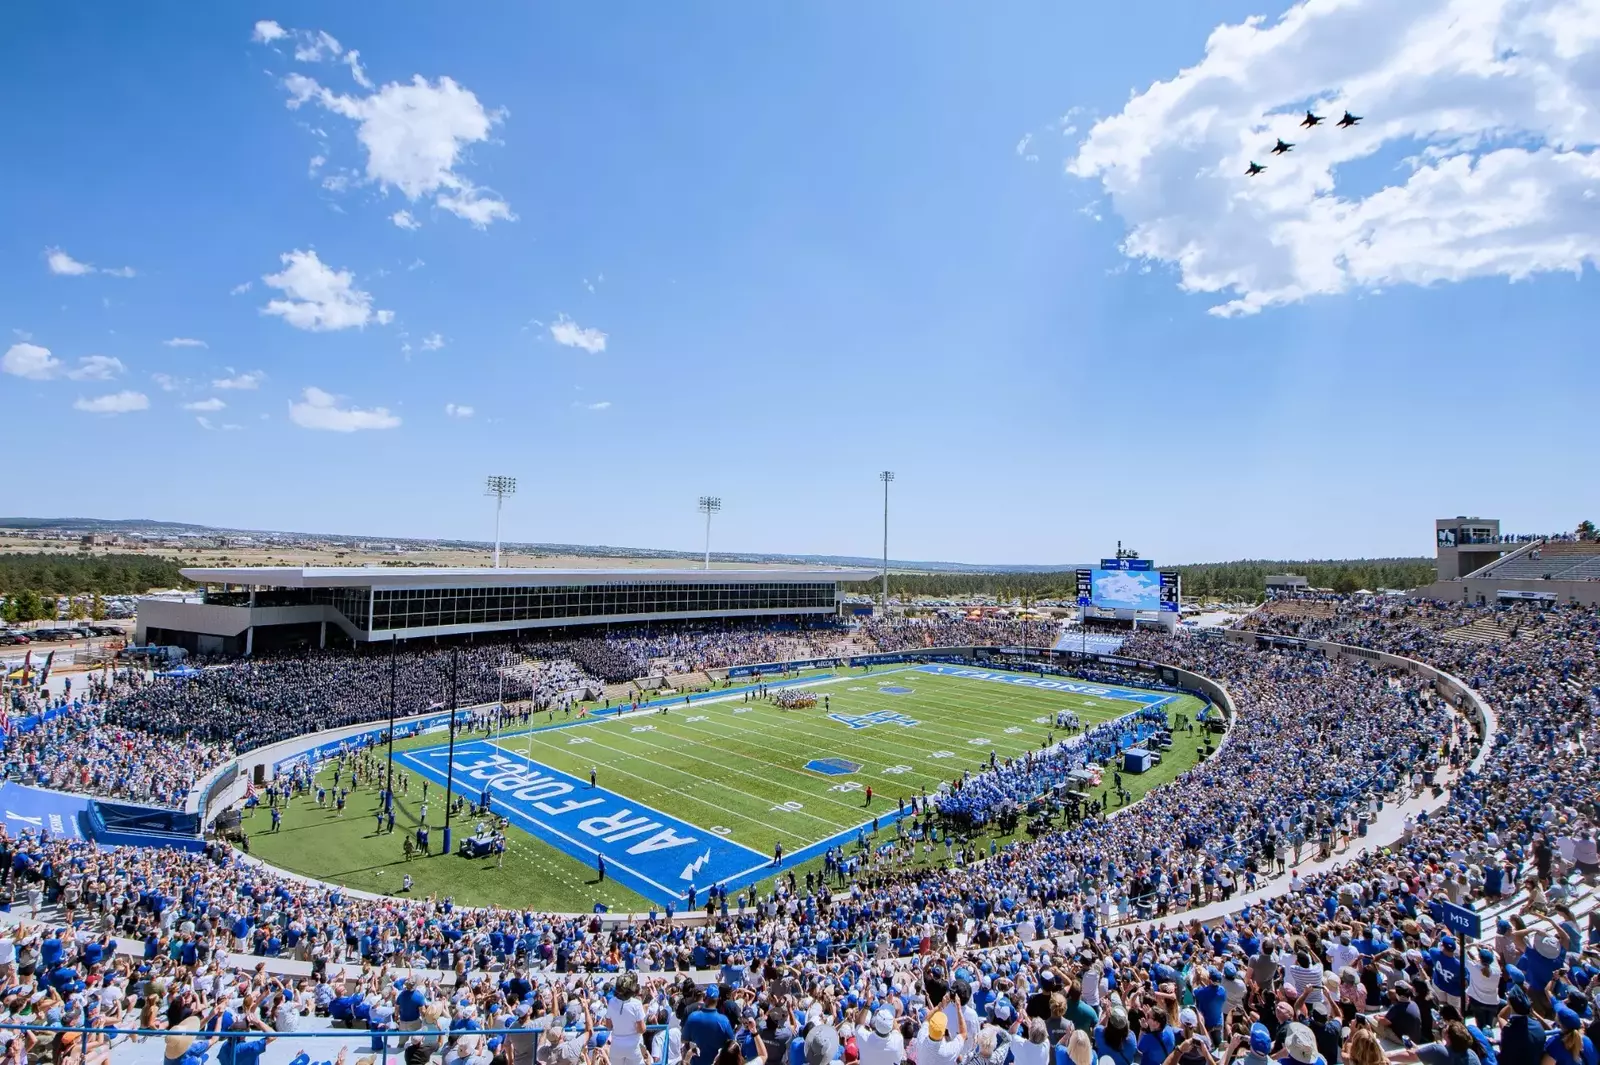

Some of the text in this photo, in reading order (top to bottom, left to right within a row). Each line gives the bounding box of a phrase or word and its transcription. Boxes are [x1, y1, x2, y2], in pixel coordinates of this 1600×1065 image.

[952, 670, 1112, 695] FALCONS
[447, 754, 698, 855] AIR FORCE
[1450, 911, 1470, 928] M13
[1435, 960, 1455, 984] AF
